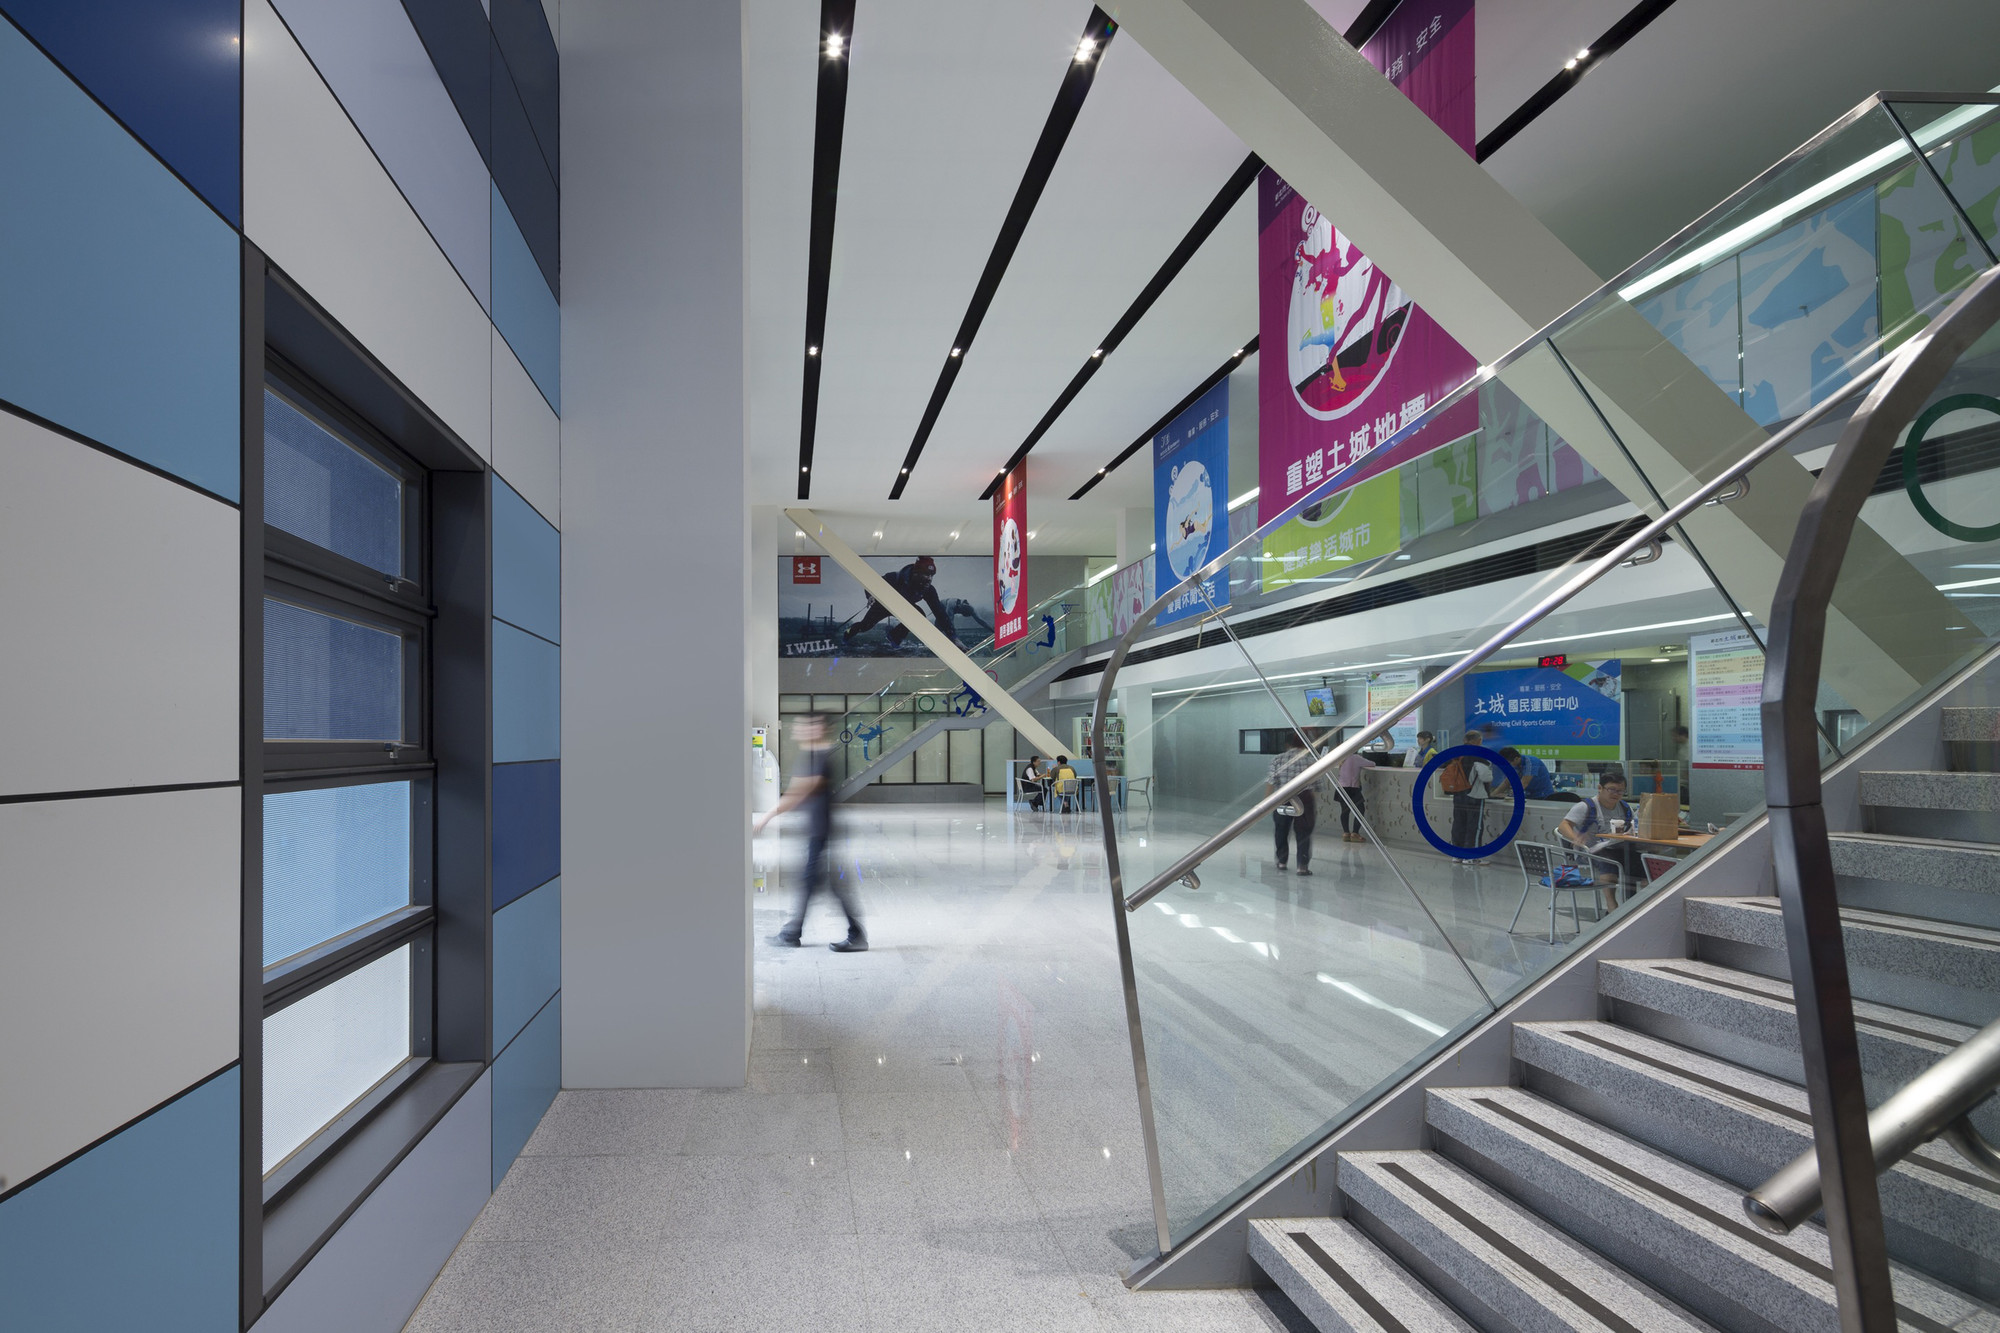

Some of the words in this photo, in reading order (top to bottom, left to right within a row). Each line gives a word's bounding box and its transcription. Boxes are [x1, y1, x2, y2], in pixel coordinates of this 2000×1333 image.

[786, 643, 794, 656] I
[793, 639, 839, 654] WILL.
[1541, 656, 1564, 667] 10:28
[1511, 719, 1522, 727] Civil
[1522, 719, 1538, 728] Sports
[1538, 719, 1557, 727] Center
